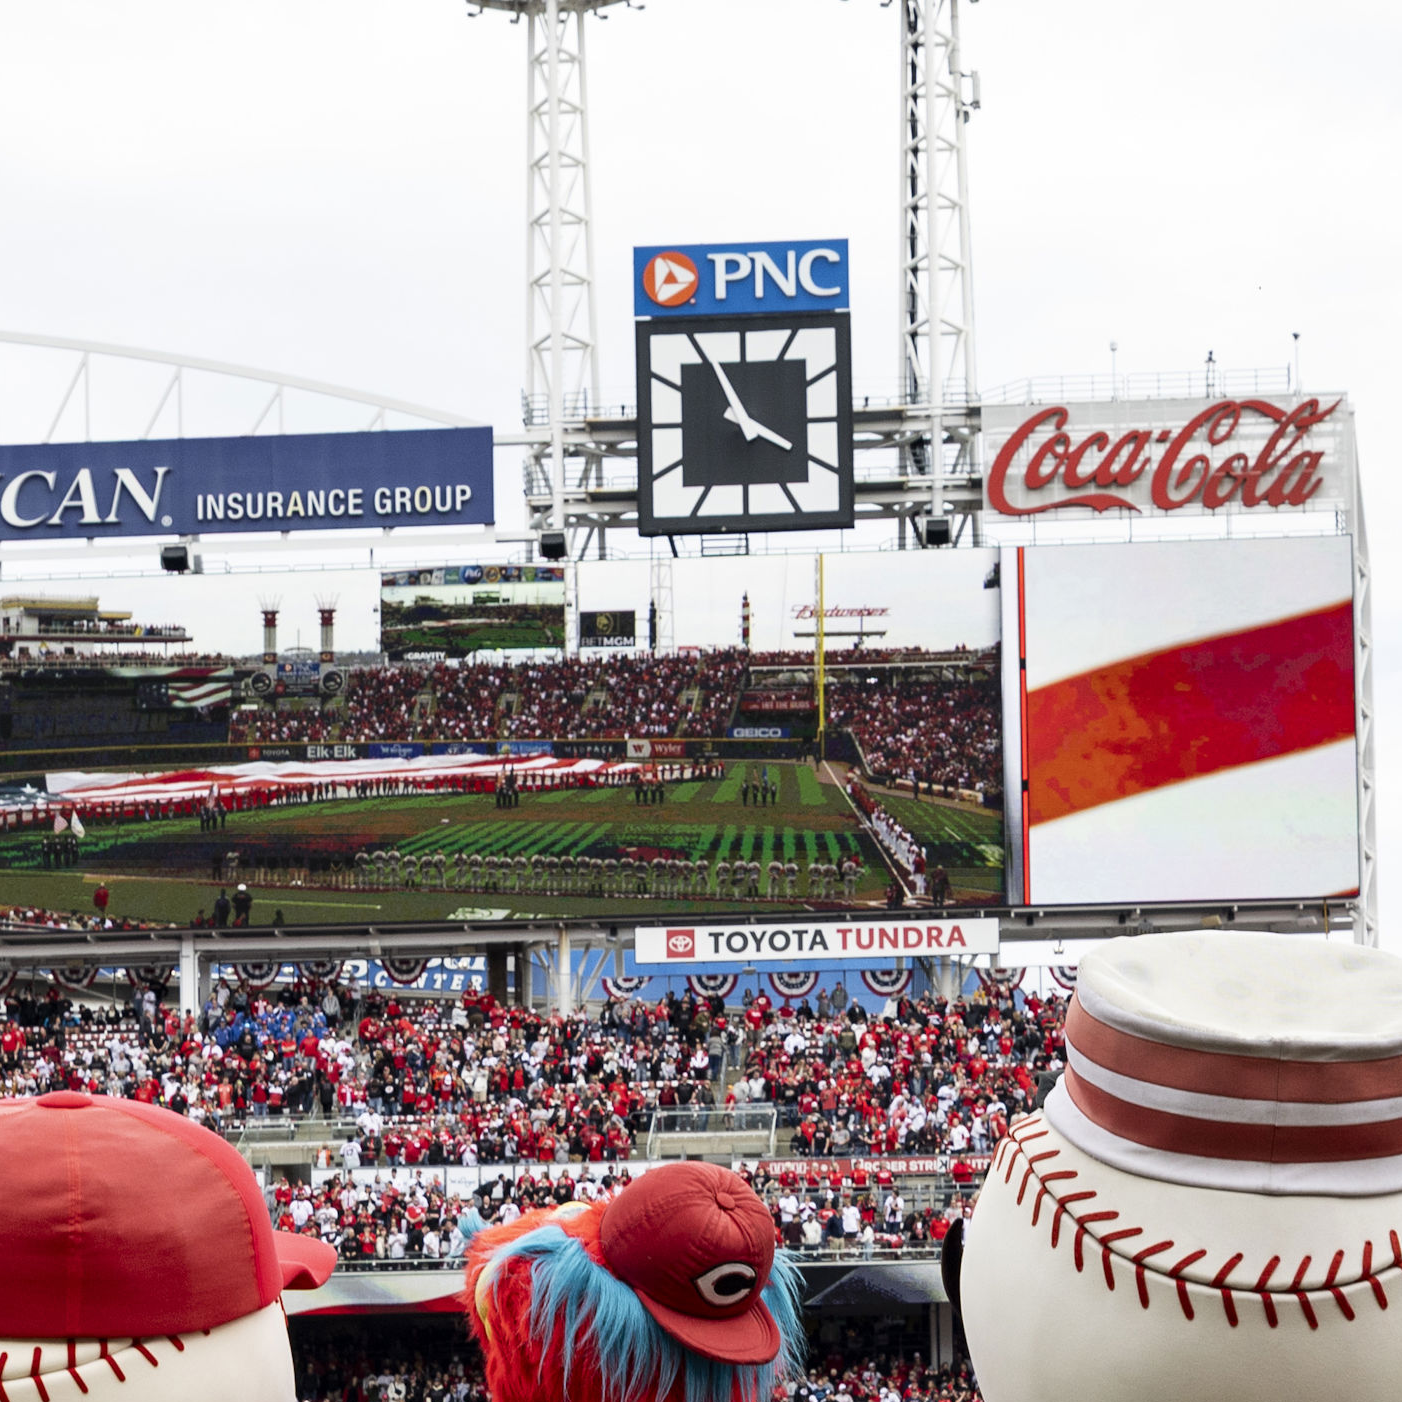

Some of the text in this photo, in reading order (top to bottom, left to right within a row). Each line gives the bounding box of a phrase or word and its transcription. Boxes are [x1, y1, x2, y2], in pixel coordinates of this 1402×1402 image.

[707, 248, 841, 300] PNC
[987, 397, 1343, 516] Coca-Cola
[196, 484, 473, 521] INSURANCE GROUP
[733, 728, 782, 738] GEICO
[708, 924, 967, 955] TOYOTA TUNDRA
[374, 972, 482, 991] CNTER
[695, 1262, 758, 1306] C
